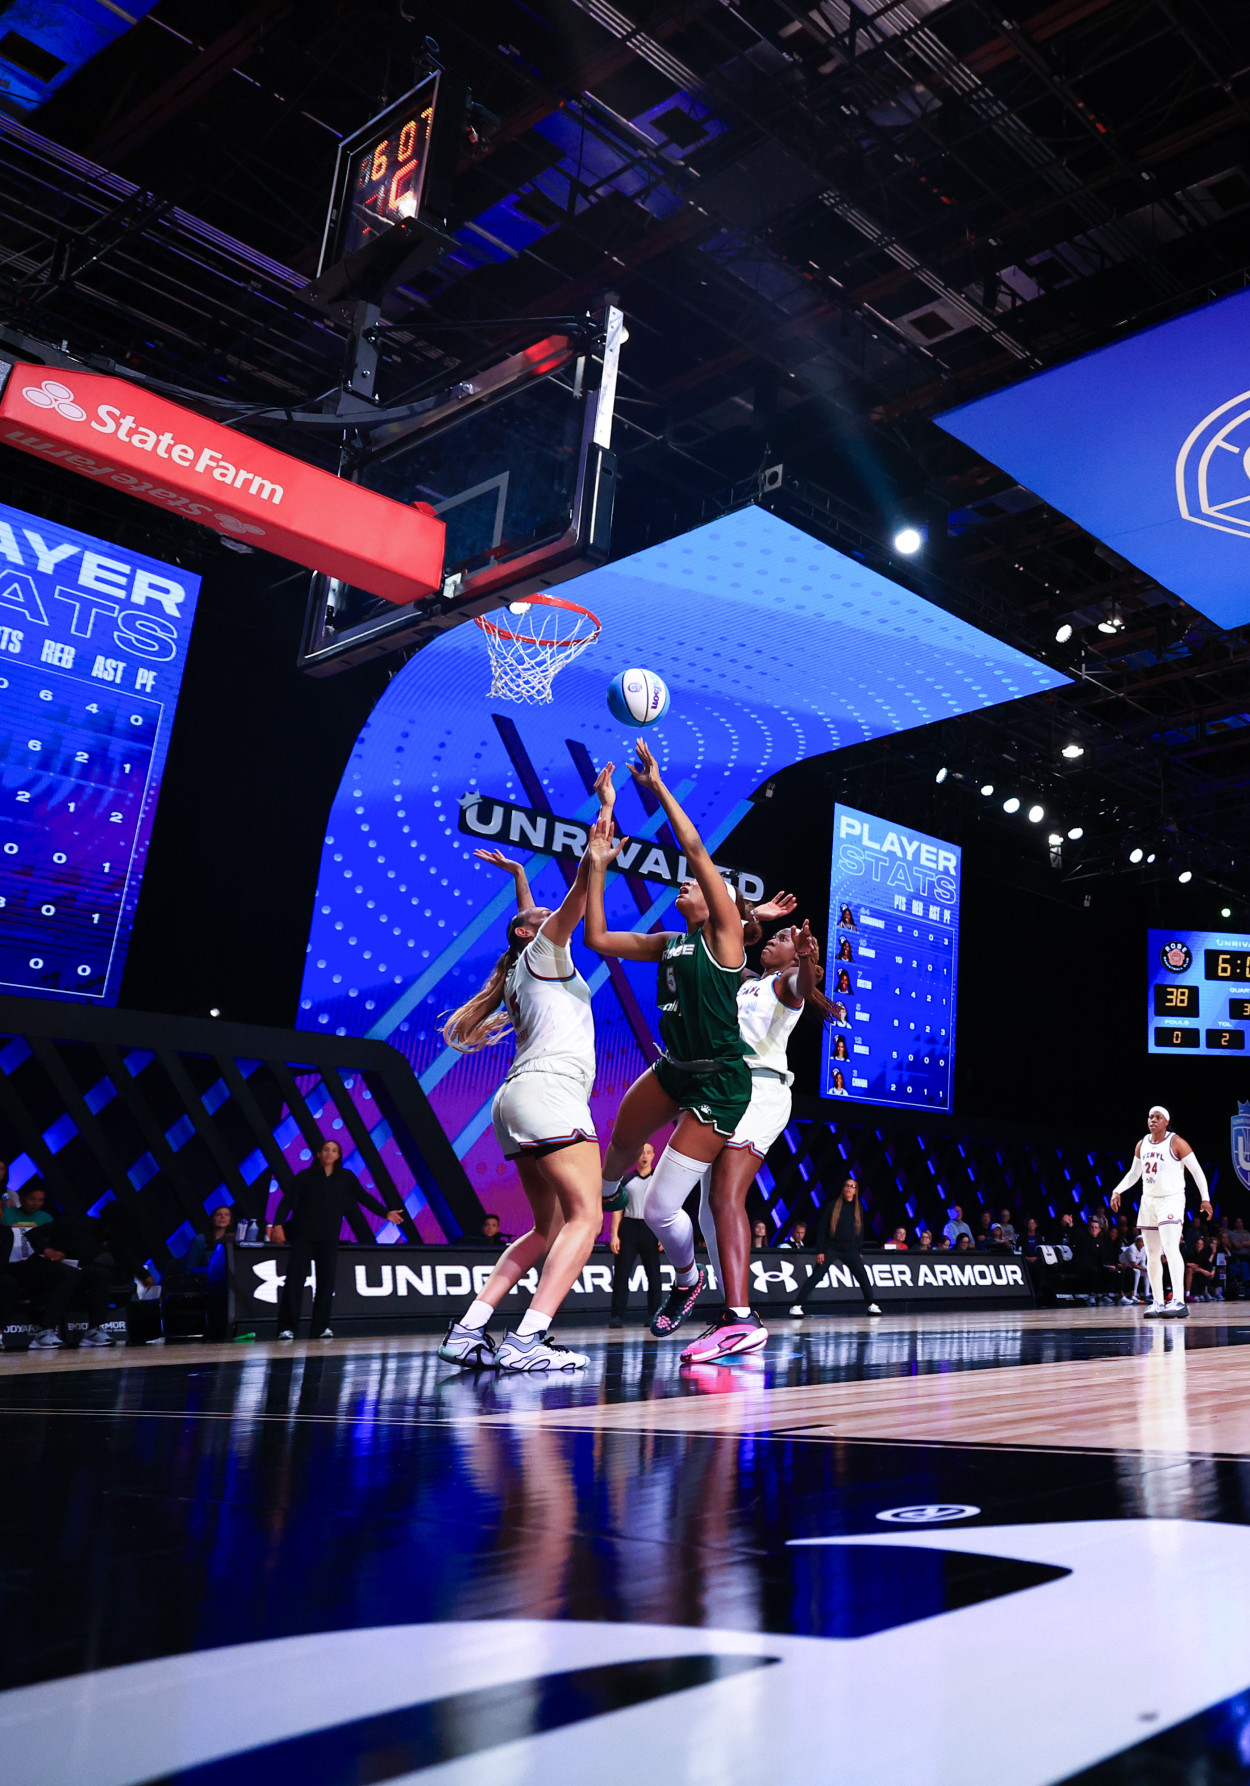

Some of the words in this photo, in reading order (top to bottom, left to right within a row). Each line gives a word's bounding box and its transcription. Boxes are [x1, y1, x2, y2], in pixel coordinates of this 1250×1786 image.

[41, 639, 76, 669] REB
[91, 655, 127, 684] AST
[135, 667, 158, 693] PF
[39, 689, 54, 701] 6
[85, 703, 99, 714] 4
[130, 714, 144, 726] 0
[28, 739, 42, 751] 6
[75, 751, 90, 763] 2
[123, 763, 132, 774] 1
[16, 791, 31, 803] 2
[68, 802, 77, 813] 1
[109, 812, 124, 824] 2
[464, 799, 765, 902] UNRVALD
[840, 815, 956, 875] PLAYER
[4, 842, 19, 854] 0
[53, 852, 67, 864] 0
[102, 862, 111, 873] 1
[839, 844, 957, 904] STATS
[41, 904, 56, 916] 0
[92, 913, 100, 924] 1
[943, 938, 949, 946] 3
[29, 957, 44, 969] 0
[77, 964, 91, 976] 0
[911, 960, 917, 968] 2
[666, 966, 677, 993] 5
[894, 987, 900, 995] 4
[910, 991, 916, 999] 4
[1165, 987, 1189, 1007] 38
[1243, 1003, 1250, 1015] 3
[925, 1025, 931, 1033] 2
[940, 1028, 946, 1036] 3
[1173, 1031, 1182, 1044] 0
[1221, 1033, 1230, 1045] 2
[892, 1051, 898, 1059] 5
[890, 1083, 896, 1091] 2
[923, 1088, 928, 1096] 1
[1142, 1151, 1165, 1162] VINYL
[1145, 1161, 1158, 1174] 24
[918, 1264, 1025, 1287] ARMOUR
